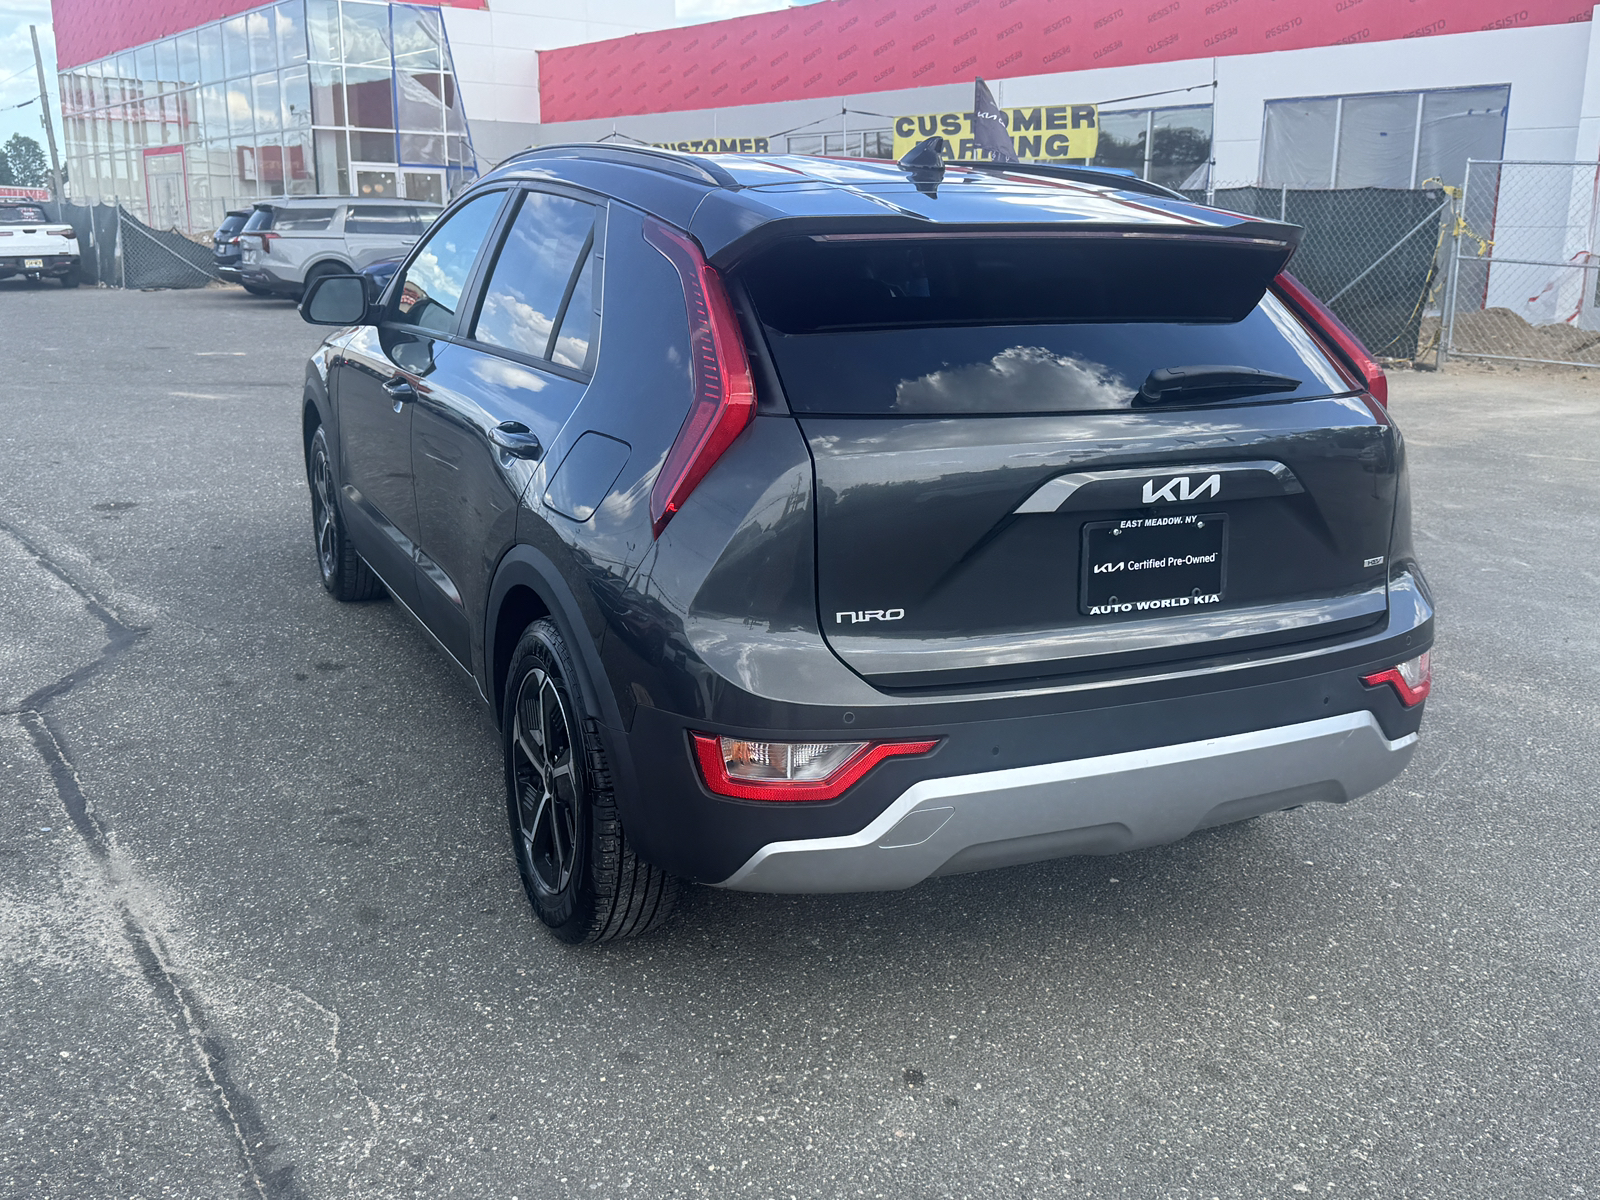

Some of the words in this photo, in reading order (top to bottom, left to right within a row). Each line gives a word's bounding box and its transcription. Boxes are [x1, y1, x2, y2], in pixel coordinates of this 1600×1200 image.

[1147, 1, 1180, 24] RESISTO
[1204, 0, 1240, 16] RESIS
[1043, 15, 1072, 36] RESISTO
[1094, 8, 1124, 30] RESISTO
[1265, 16, 1303, 39] RESISTO
[953, 27, 978, 46] RESISTO
[996, 21, 1023, 41] RESISTO
[1203, 26, 1238, 48] RESISTO
[1331, 28, 1370, 45] ESISTO
[912, 33, 936, 52] RESISTO
[1092, 40, 1124, 60] RESISTO
[1146, 32, 1179, 54] RESISTO
[952, 55, 978, 74] RESISTO
[996, 50, 1023, 70] RESISTO
[1042, 45, 1071, 65] RESISTO
[916, 133, 1071, 160] ARNG
[1141, 474, 1221, 504] KIA
[1120, 520, 1143, 529] EAST
[1185, 515, 1198, 524] NY
[1094, 561, 1125, 574] KIA
[1128, 558, 1166, 571] Certified
[1089, 603, 1132, 616] AUTO
[1136, 597, 1190, 611] WORLD
[1193, 594, 1220, 605] KIA
[836, 608, 905, 624] NIRO
